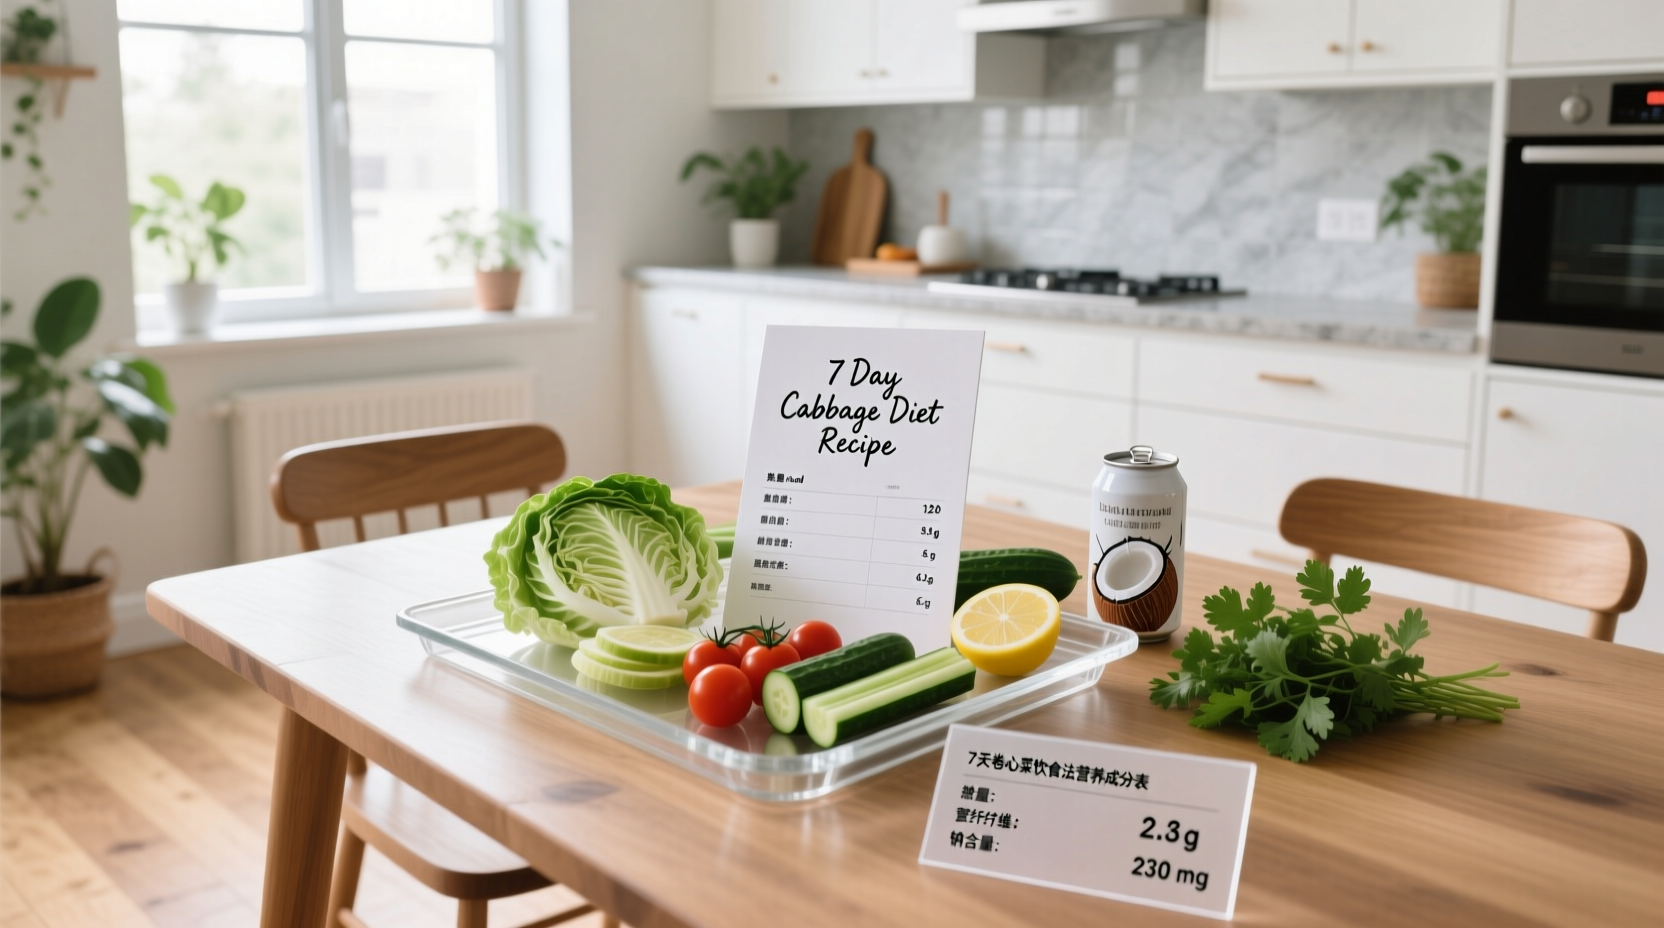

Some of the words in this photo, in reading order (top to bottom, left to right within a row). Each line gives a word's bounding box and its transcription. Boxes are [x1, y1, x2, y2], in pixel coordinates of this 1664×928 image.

[829, 359, 845, 385] 7
[850, 357, 902, 400] Day
[780, 390, 881, 433] Cabbage
[889, 395, 944, 424] Diet
[818, 426, 896, 467] Recipe
[922, 504, 941, 514] 120
[1131, 856, 1171, 881] 230
[1176, 868, 1209, 892] mg
